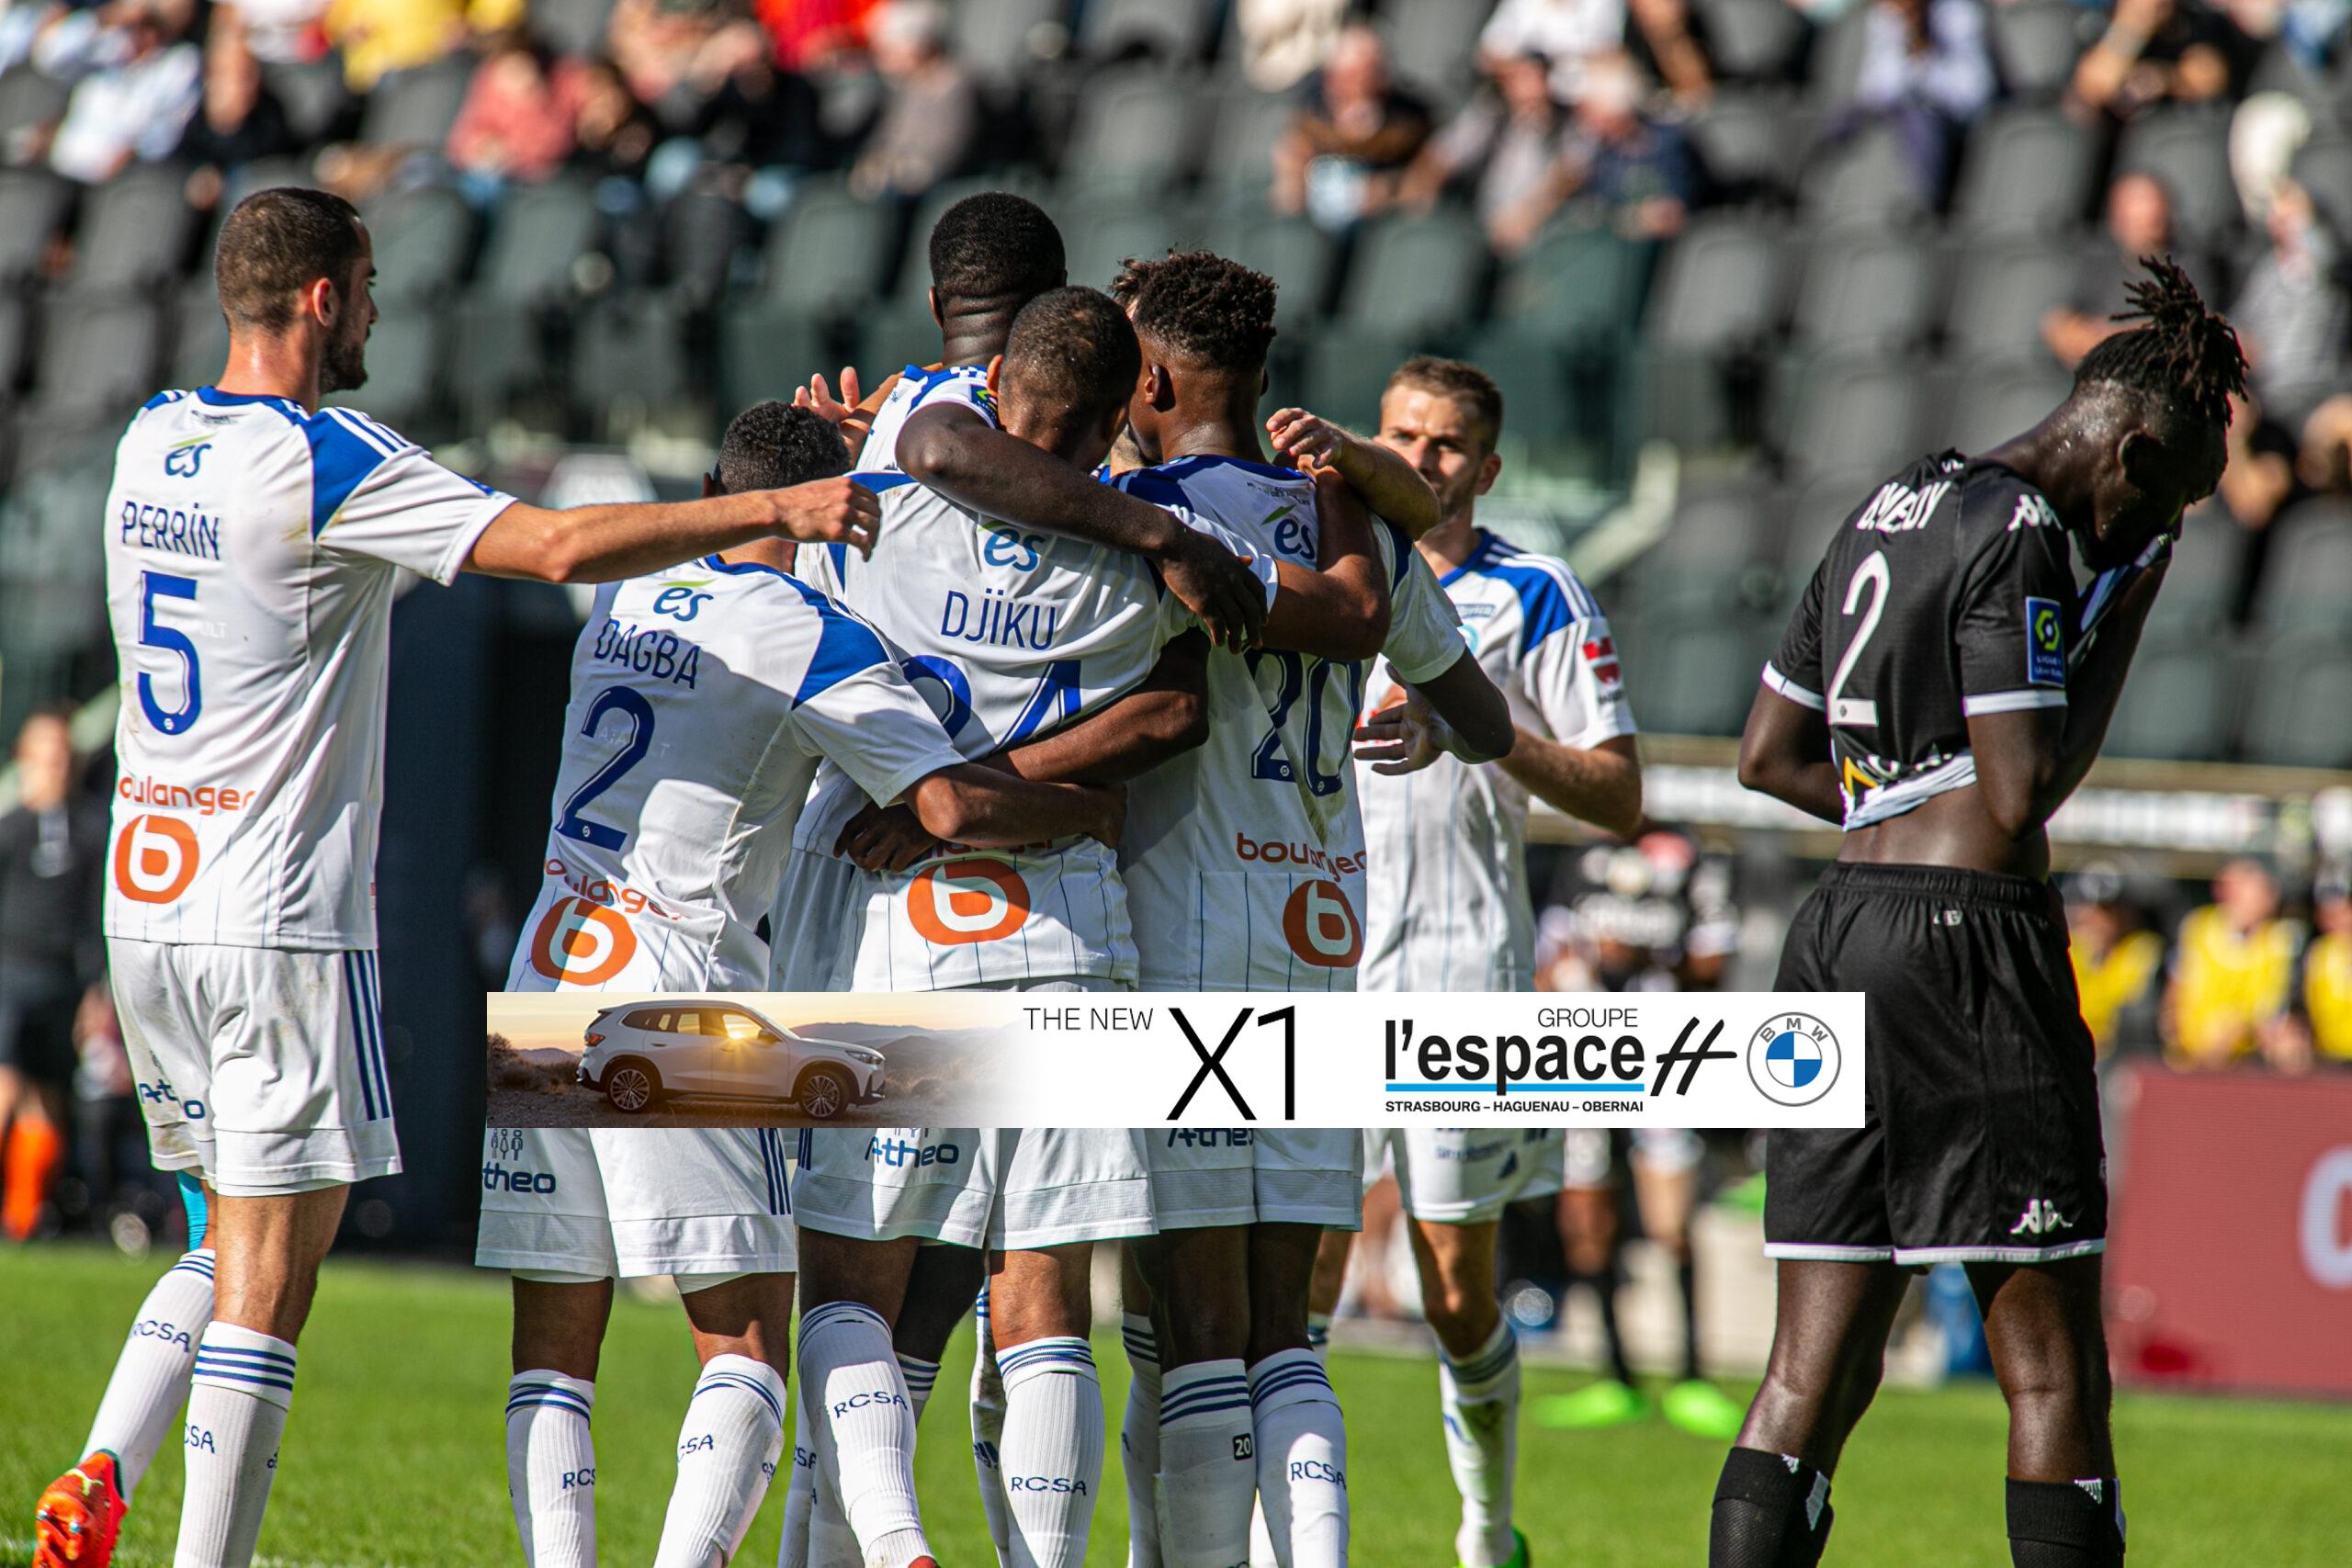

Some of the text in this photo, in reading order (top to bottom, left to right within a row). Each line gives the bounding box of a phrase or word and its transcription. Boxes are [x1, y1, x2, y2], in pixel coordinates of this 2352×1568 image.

[137, 570, 202, 736] 5
[594, 618, 702, 690] DAGBA
[1826, 549, 1892, 727] 2
[1242, 646, 1363, 796] 20
[551, 685, 656, 852] 2
[119, 775, 256, 816] oulanger
[139, 1078, 206, 1120] Ato
[865, 1135, 960, 1168] Atheo
[482, 1160, 557, 1194] theo
[834, 1391, 909, 1418] RCSA
[1235, 1437, 1251, 1457] 20
[562, 1468, 596, 1490] RCS
[1011, 1475, 1087, 1496] RCSA
[1290, 1460, 1347, 1491] RCSA
